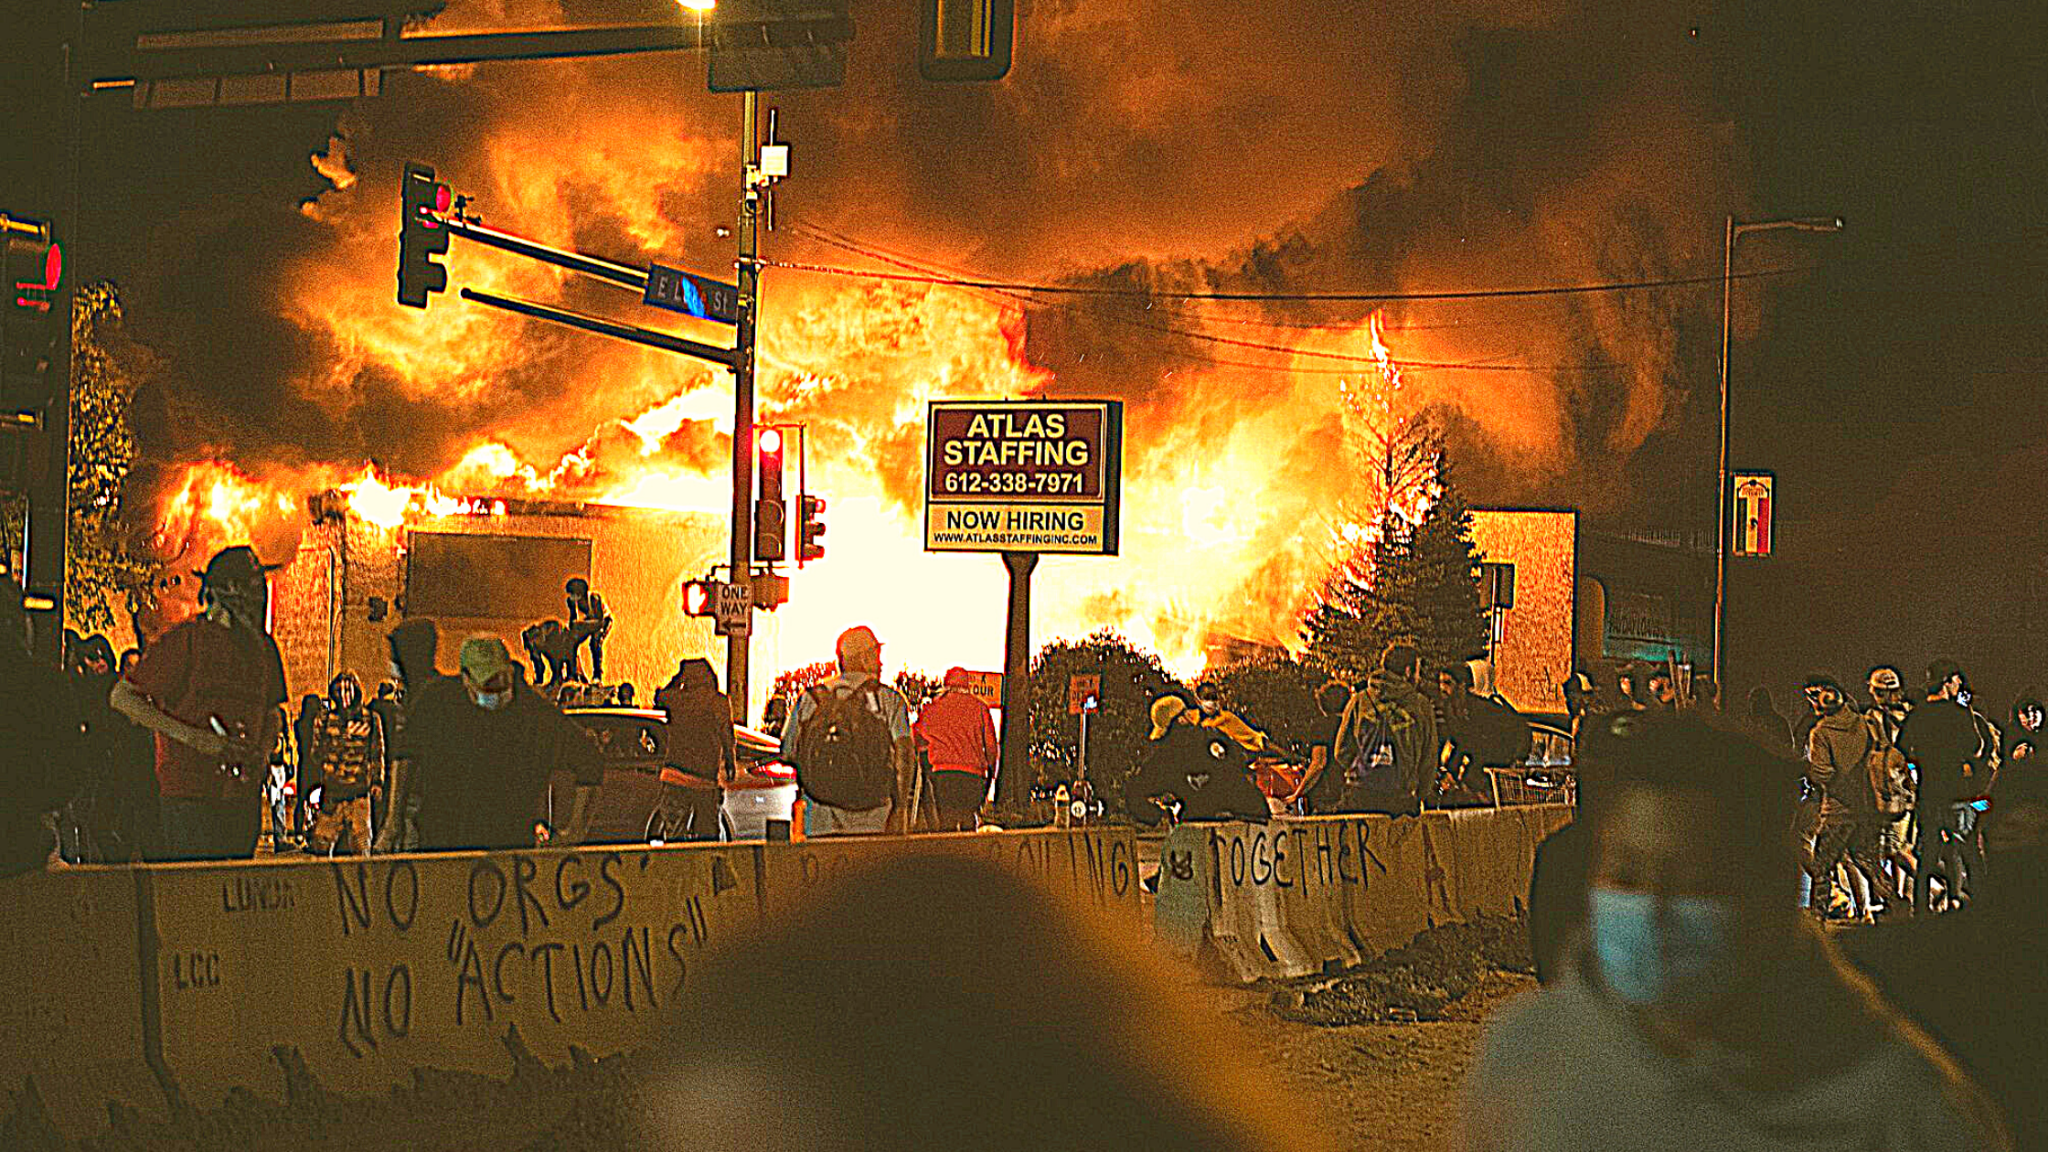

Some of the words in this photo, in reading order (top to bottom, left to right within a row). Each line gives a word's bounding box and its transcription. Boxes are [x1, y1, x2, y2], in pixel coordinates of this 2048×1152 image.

[657, 275, 669, 299] E
[713, 290, 728, 315] St
[966, 413, 1065, 438] ATLAS
[943, 440, 1089, 466] STAFFING
[945, 472, 1083, 493] 612-338-7971
[947, 511, 1000, 530] NOW
[1006, 511, 1084, 531] HIRING
[933, 532, 1097, 545] WWW.ATLASSTAFFINGINC.COM
[721, 586, 748, 600] ONE
[720, 601, 748, 615] WAY
[972, 684, 994, 698] OUR
[1208, 820, 1387, 907] TOGETHER
[333, 860, 419, 936] NO
[339, 963, 412, 1058] NO
